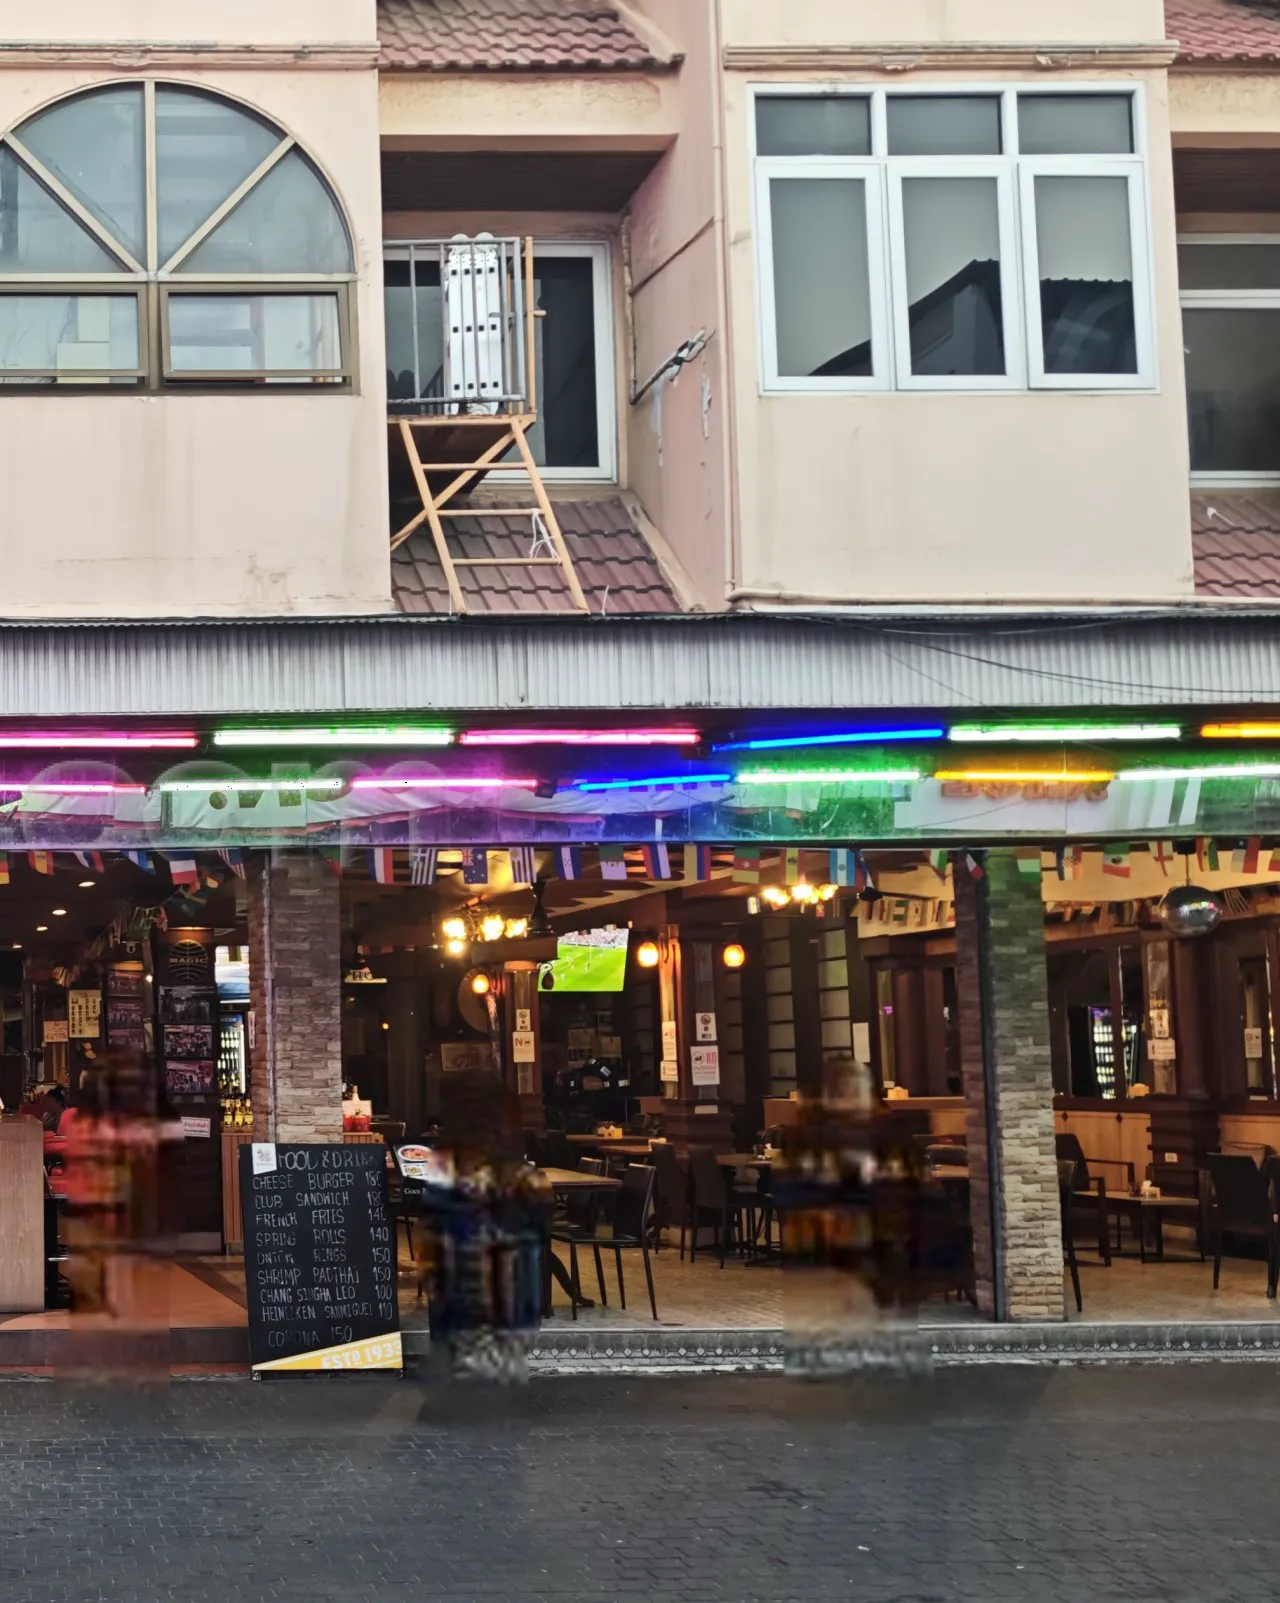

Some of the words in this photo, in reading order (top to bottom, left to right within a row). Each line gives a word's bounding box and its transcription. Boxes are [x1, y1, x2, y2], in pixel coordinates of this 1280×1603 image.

[252, 1174, 295, 1190] CHEESE
[308, 1171, 355, 1190] BURGER
[254, 1194, 284, 1210] CLUB
[295, 1191, 349, 1207] SANDWICH
[255, 1211, 298, 1228] FRENCH
[312, 1208, 345, 1225] FRIES
[256, 1231, 296, 1247] SPRING
[313, 1228, 348, 1245] ROLLS
[369, 1226, 389, 1242] 140
[372, 1246, 391, 1264] 150
[257, 1268, 301, 1286] SHRIMP
[372, 1266, 392, 1282] 150
[260, 1288, 293, 1304] CHANG
[297, 1286, 332, 1302] SINGHA
[335, 1285, 356, 1301] LEO
[374, 1284, 393, 1300] 100
[268, 1330, 321, 1348] CORONA
[331, 1325, 353, 1342] 150
